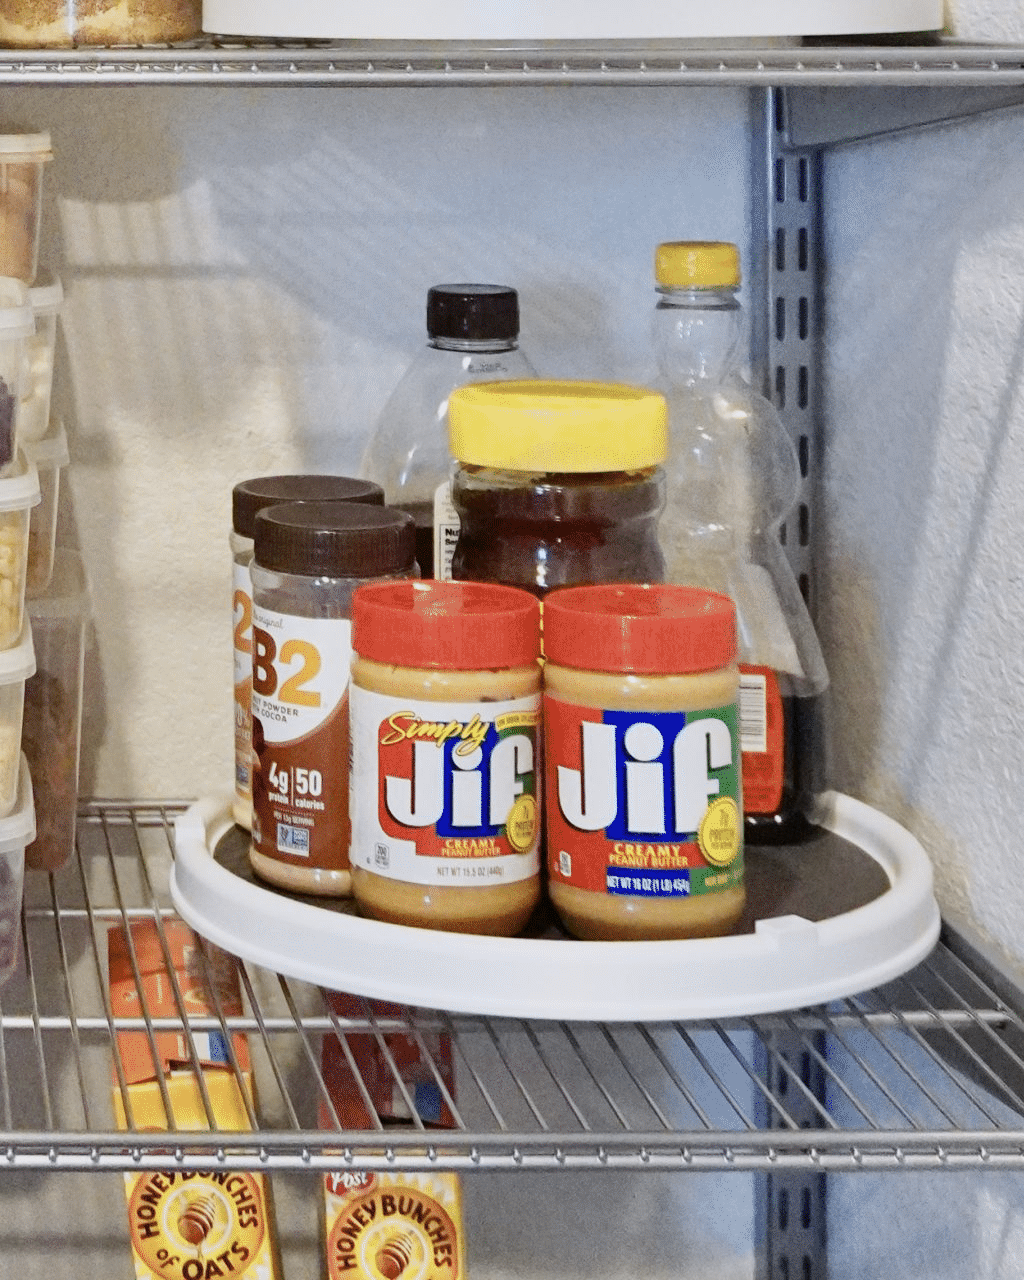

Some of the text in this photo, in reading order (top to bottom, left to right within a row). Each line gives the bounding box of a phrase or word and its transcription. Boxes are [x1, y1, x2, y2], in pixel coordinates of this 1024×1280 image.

[380, 710, 491, 757] Simply
[296, 767, 323, 797] 50
[385, 733, 534, 828] Jif
[556, 717, 733, 835] Jif
[445, 839, 496, 849] CREAMY
[609, 853, 689, 868] PEANUT BUTTER
[614, 843, 680, 857] CREAMY
[136, 1171, 176, 1240] HONEY
[336, 1194, 453, 1272] HONEY BUNCHES
[181, 1240, 250, 1280] OATS
